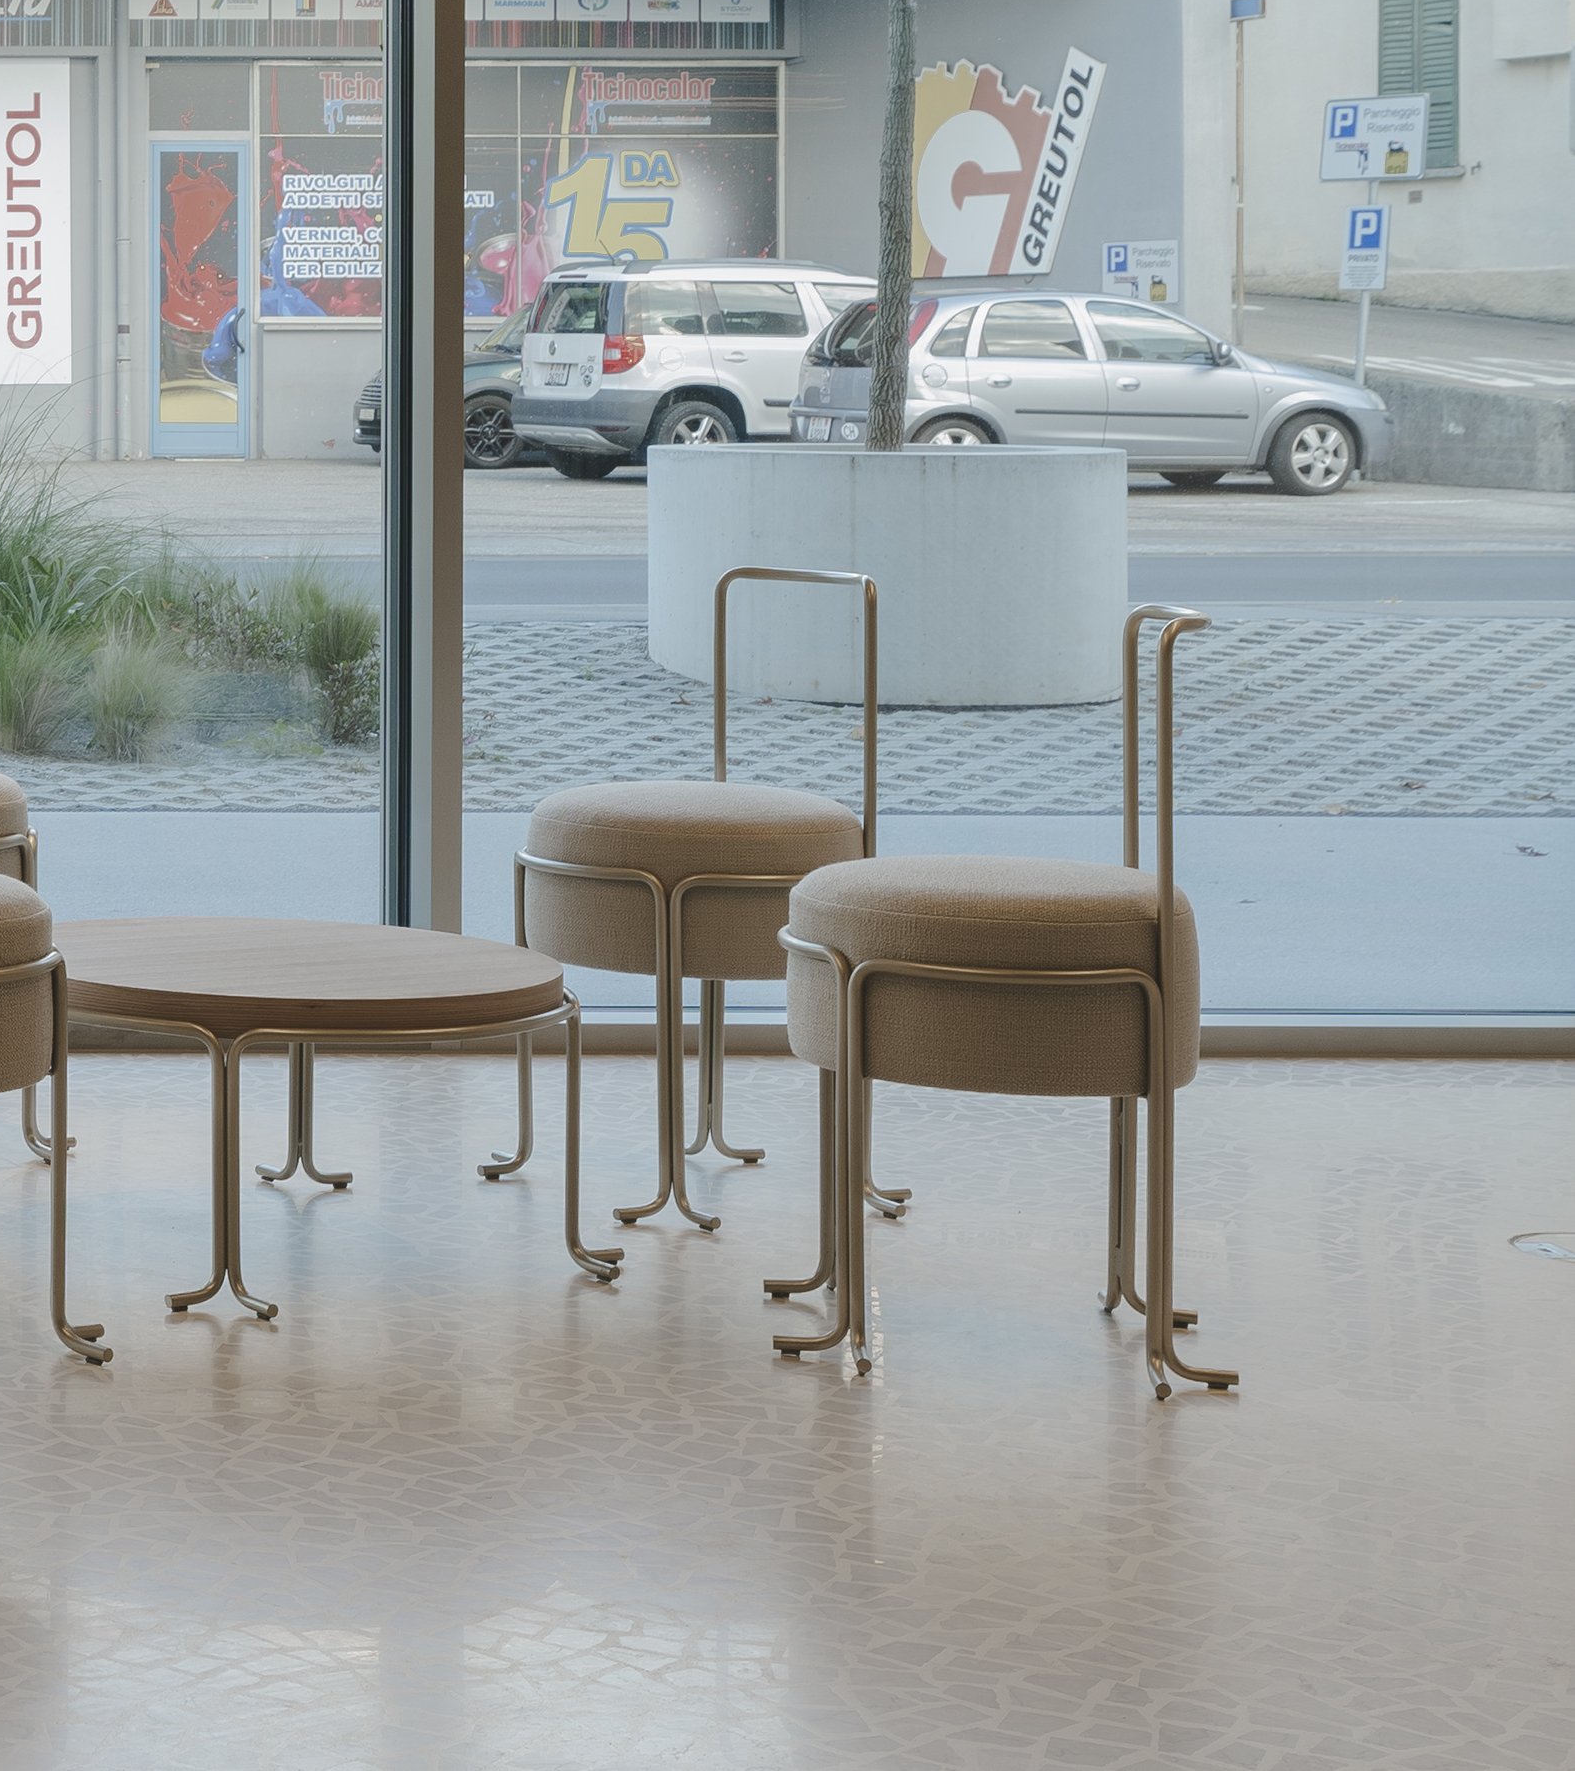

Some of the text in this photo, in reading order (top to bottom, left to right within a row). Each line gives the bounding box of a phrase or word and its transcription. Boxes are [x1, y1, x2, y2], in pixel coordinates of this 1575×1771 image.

[494, 0, 547, 8] MARMORAN
[581, 72, 716, 101] Ticinocolor
[1363, 106, 1422, 120] Parcheggio
[1367, 122, 1416, 134] Riservato
[622, 153, 677, 184] DA
[1022, 65, 1094, 267] GREUTOL
[284, 177, 372, 189] RIVOLGITI
[284, 194, 359, 206] ADDETTI
[544, 153, 674, 262] 15
[5, 91, 43, 351] GREUTOL
[284, 229, 361, 243] VERNICI,
[284, 246, 378, 258] MATERIALI
[1132, 246, 1175, 258] Parcheggio
[284, 263, 321, 276] PER
[1136, 259, 1172, 269] Riservato
[843, 425, 856, 438] CH
